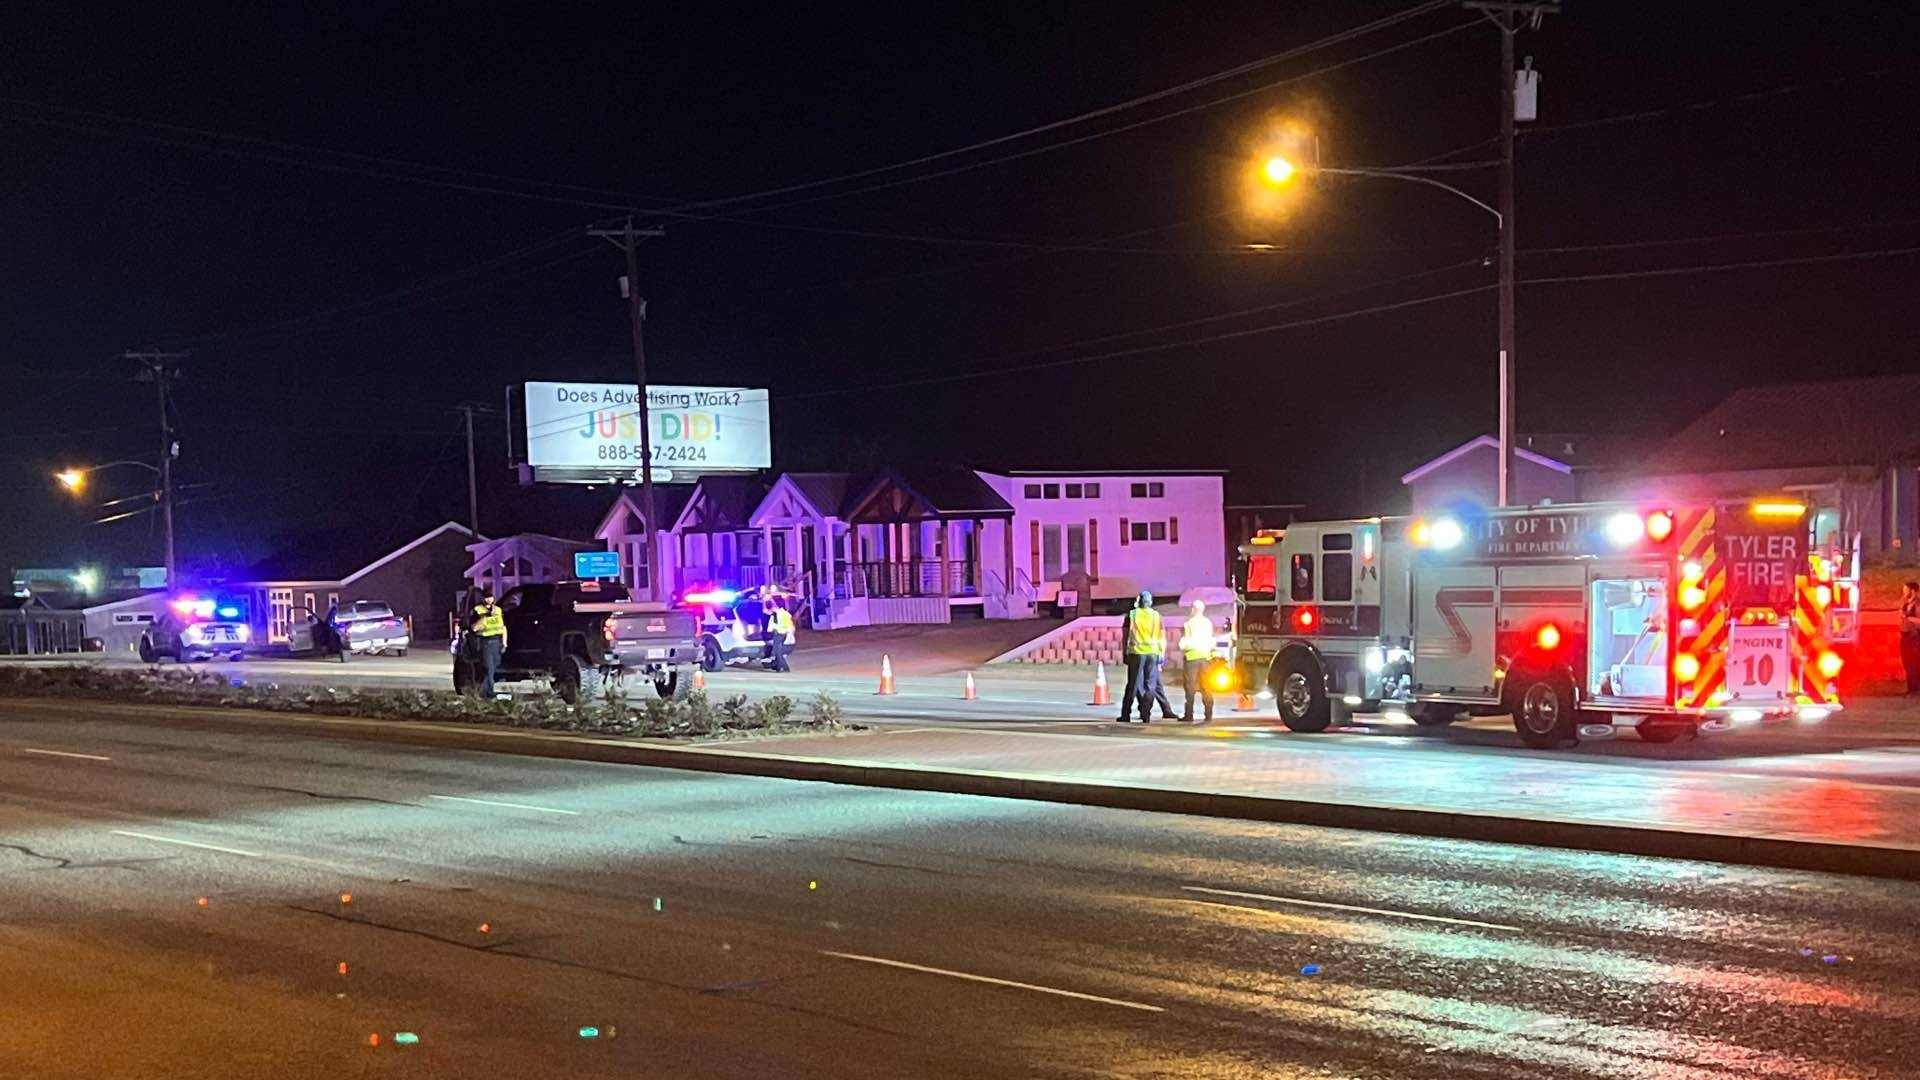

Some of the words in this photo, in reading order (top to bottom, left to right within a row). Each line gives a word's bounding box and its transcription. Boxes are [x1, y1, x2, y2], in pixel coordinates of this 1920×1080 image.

[557, 388, 597, 403] Does
[603, 388, 689, 408] Advetising
[695, 391, 740, 406] Work?
[661, 413, 721, 441] DID!
[598, 444, 706, 461] 888-57-2424
[1465, 518, 1507, 540] ITY
[1515, 518, 1540, 535] OF
[1488, 543, 1510, 554] FIRE
[1724, 535, 1796, 559] TYLER
[1734, 562, 1784, 585] FIRE
[1743, 654, 1774, 686] 10
